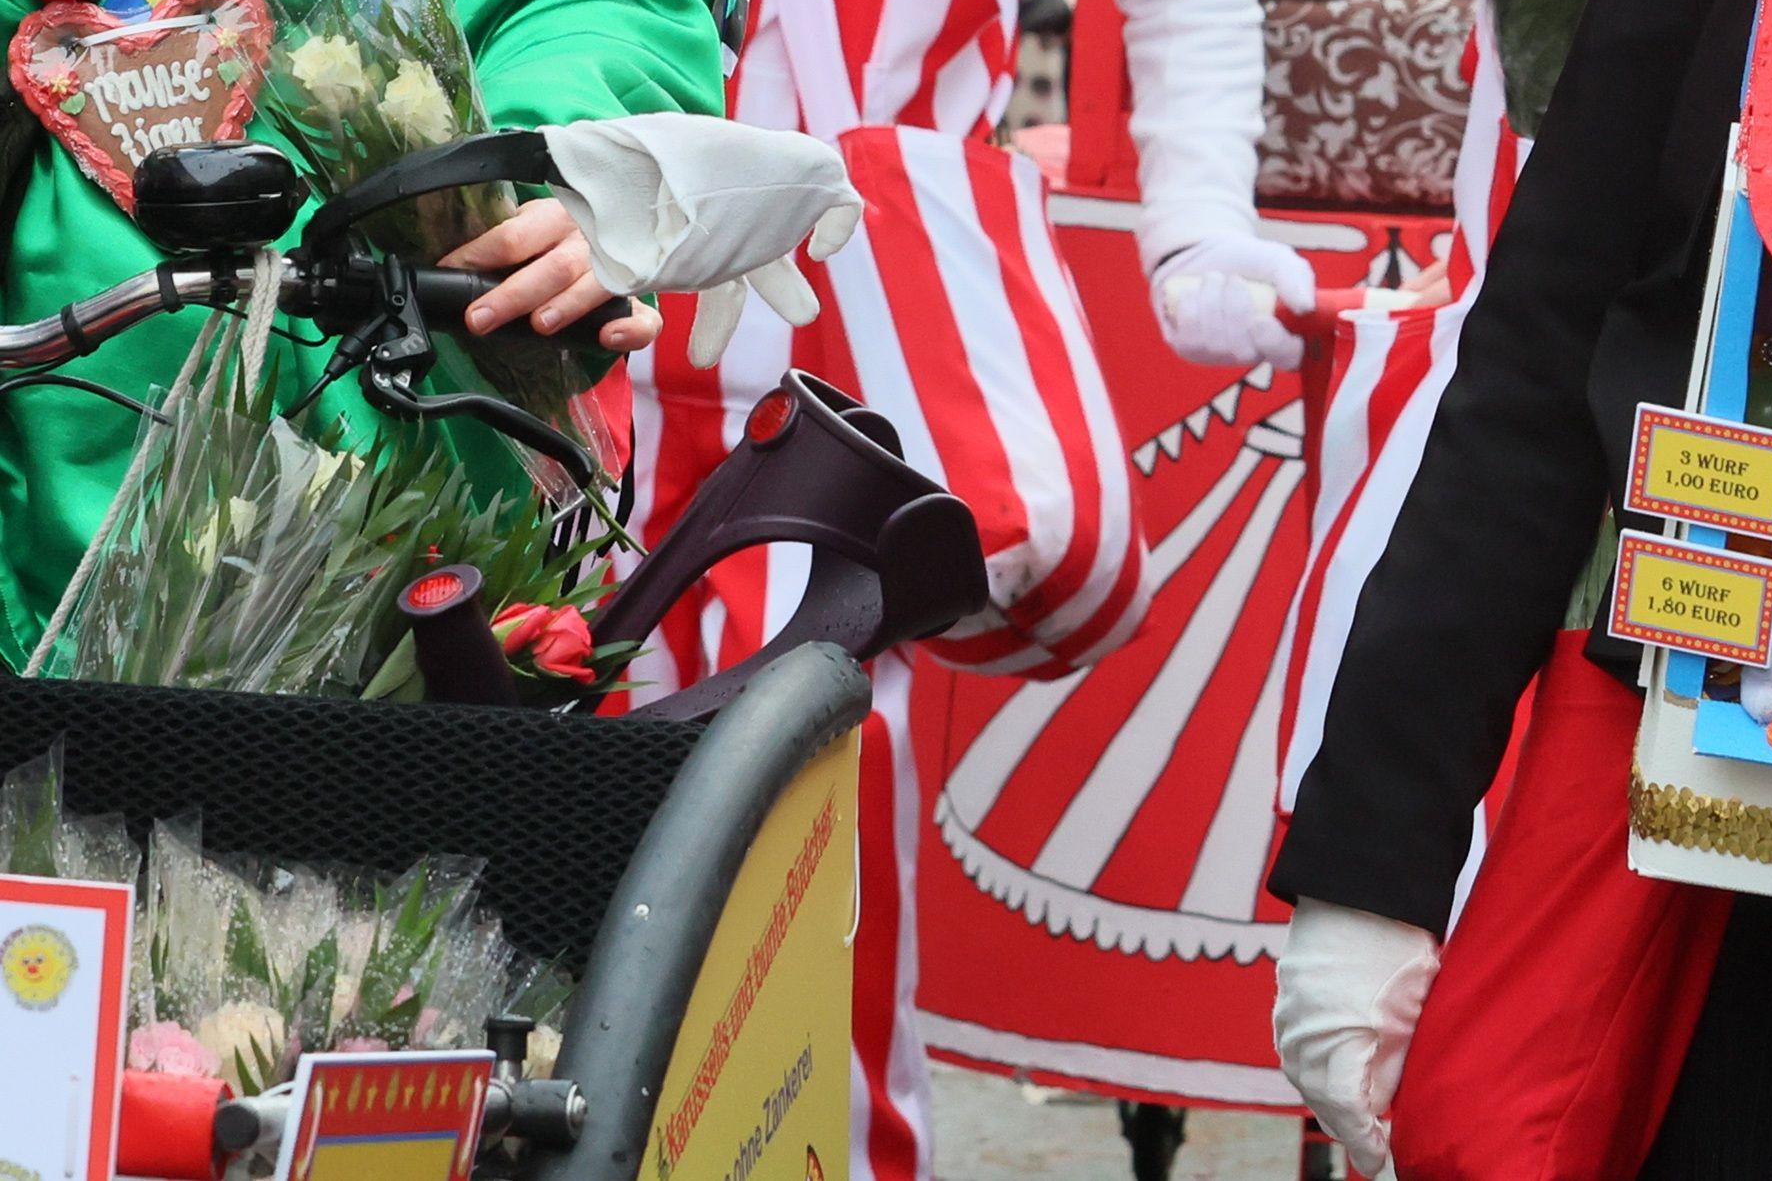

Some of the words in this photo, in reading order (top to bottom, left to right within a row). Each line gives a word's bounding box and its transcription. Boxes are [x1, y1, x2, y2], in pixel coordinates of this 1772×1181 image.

[1679, 450, 1692, 466] 3
[1697, 453, 1750, 477] WURF
[1665, 470, 1704, 491] 1,00
[1709, 480, 1760, 501] EURO
[1661, 576, 1674, 592] 6
[1679, 579, 1731, 603] WURF
[1648, 596, 1687, 617] 1,80
[1691, 605, 1742, 628] EURO
[762, 1032, 813, 1145] Zänkerei
